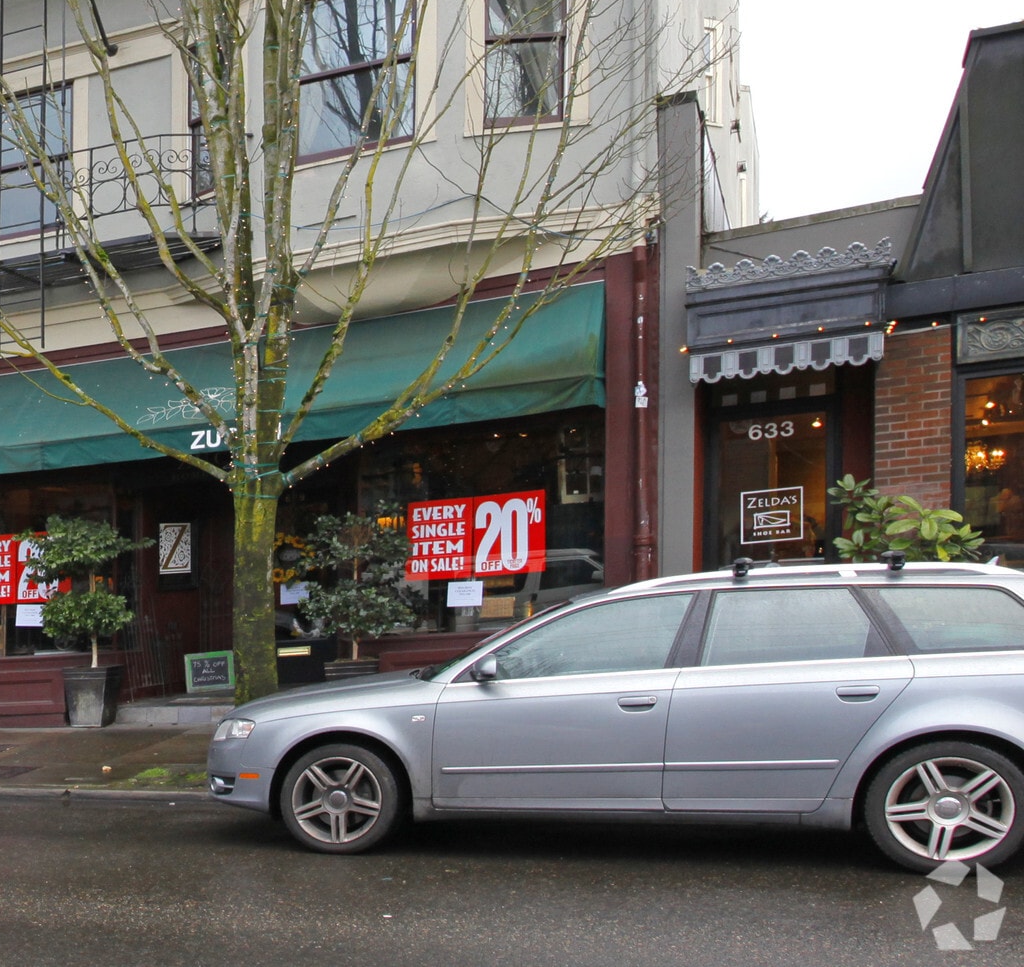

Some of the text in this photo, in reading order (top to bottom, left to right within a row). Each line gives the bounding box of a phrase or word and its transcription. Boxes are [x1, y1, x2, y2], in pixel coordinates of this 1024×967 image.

[748, 421, 794, 440] 633
[747, 495, 798, 509] ZELDA'S
[412, 504, 466, 522] EVERY
[411, 522, 466, 539] SINGLE
[475, 497, 542, 573] 20%
[412, 539, 464, 556] ITEM
[411, 557, 464, 573] ON SALE!
[481, 561, 500, 571] OFF
[22, 590, 38, 599] OFF
